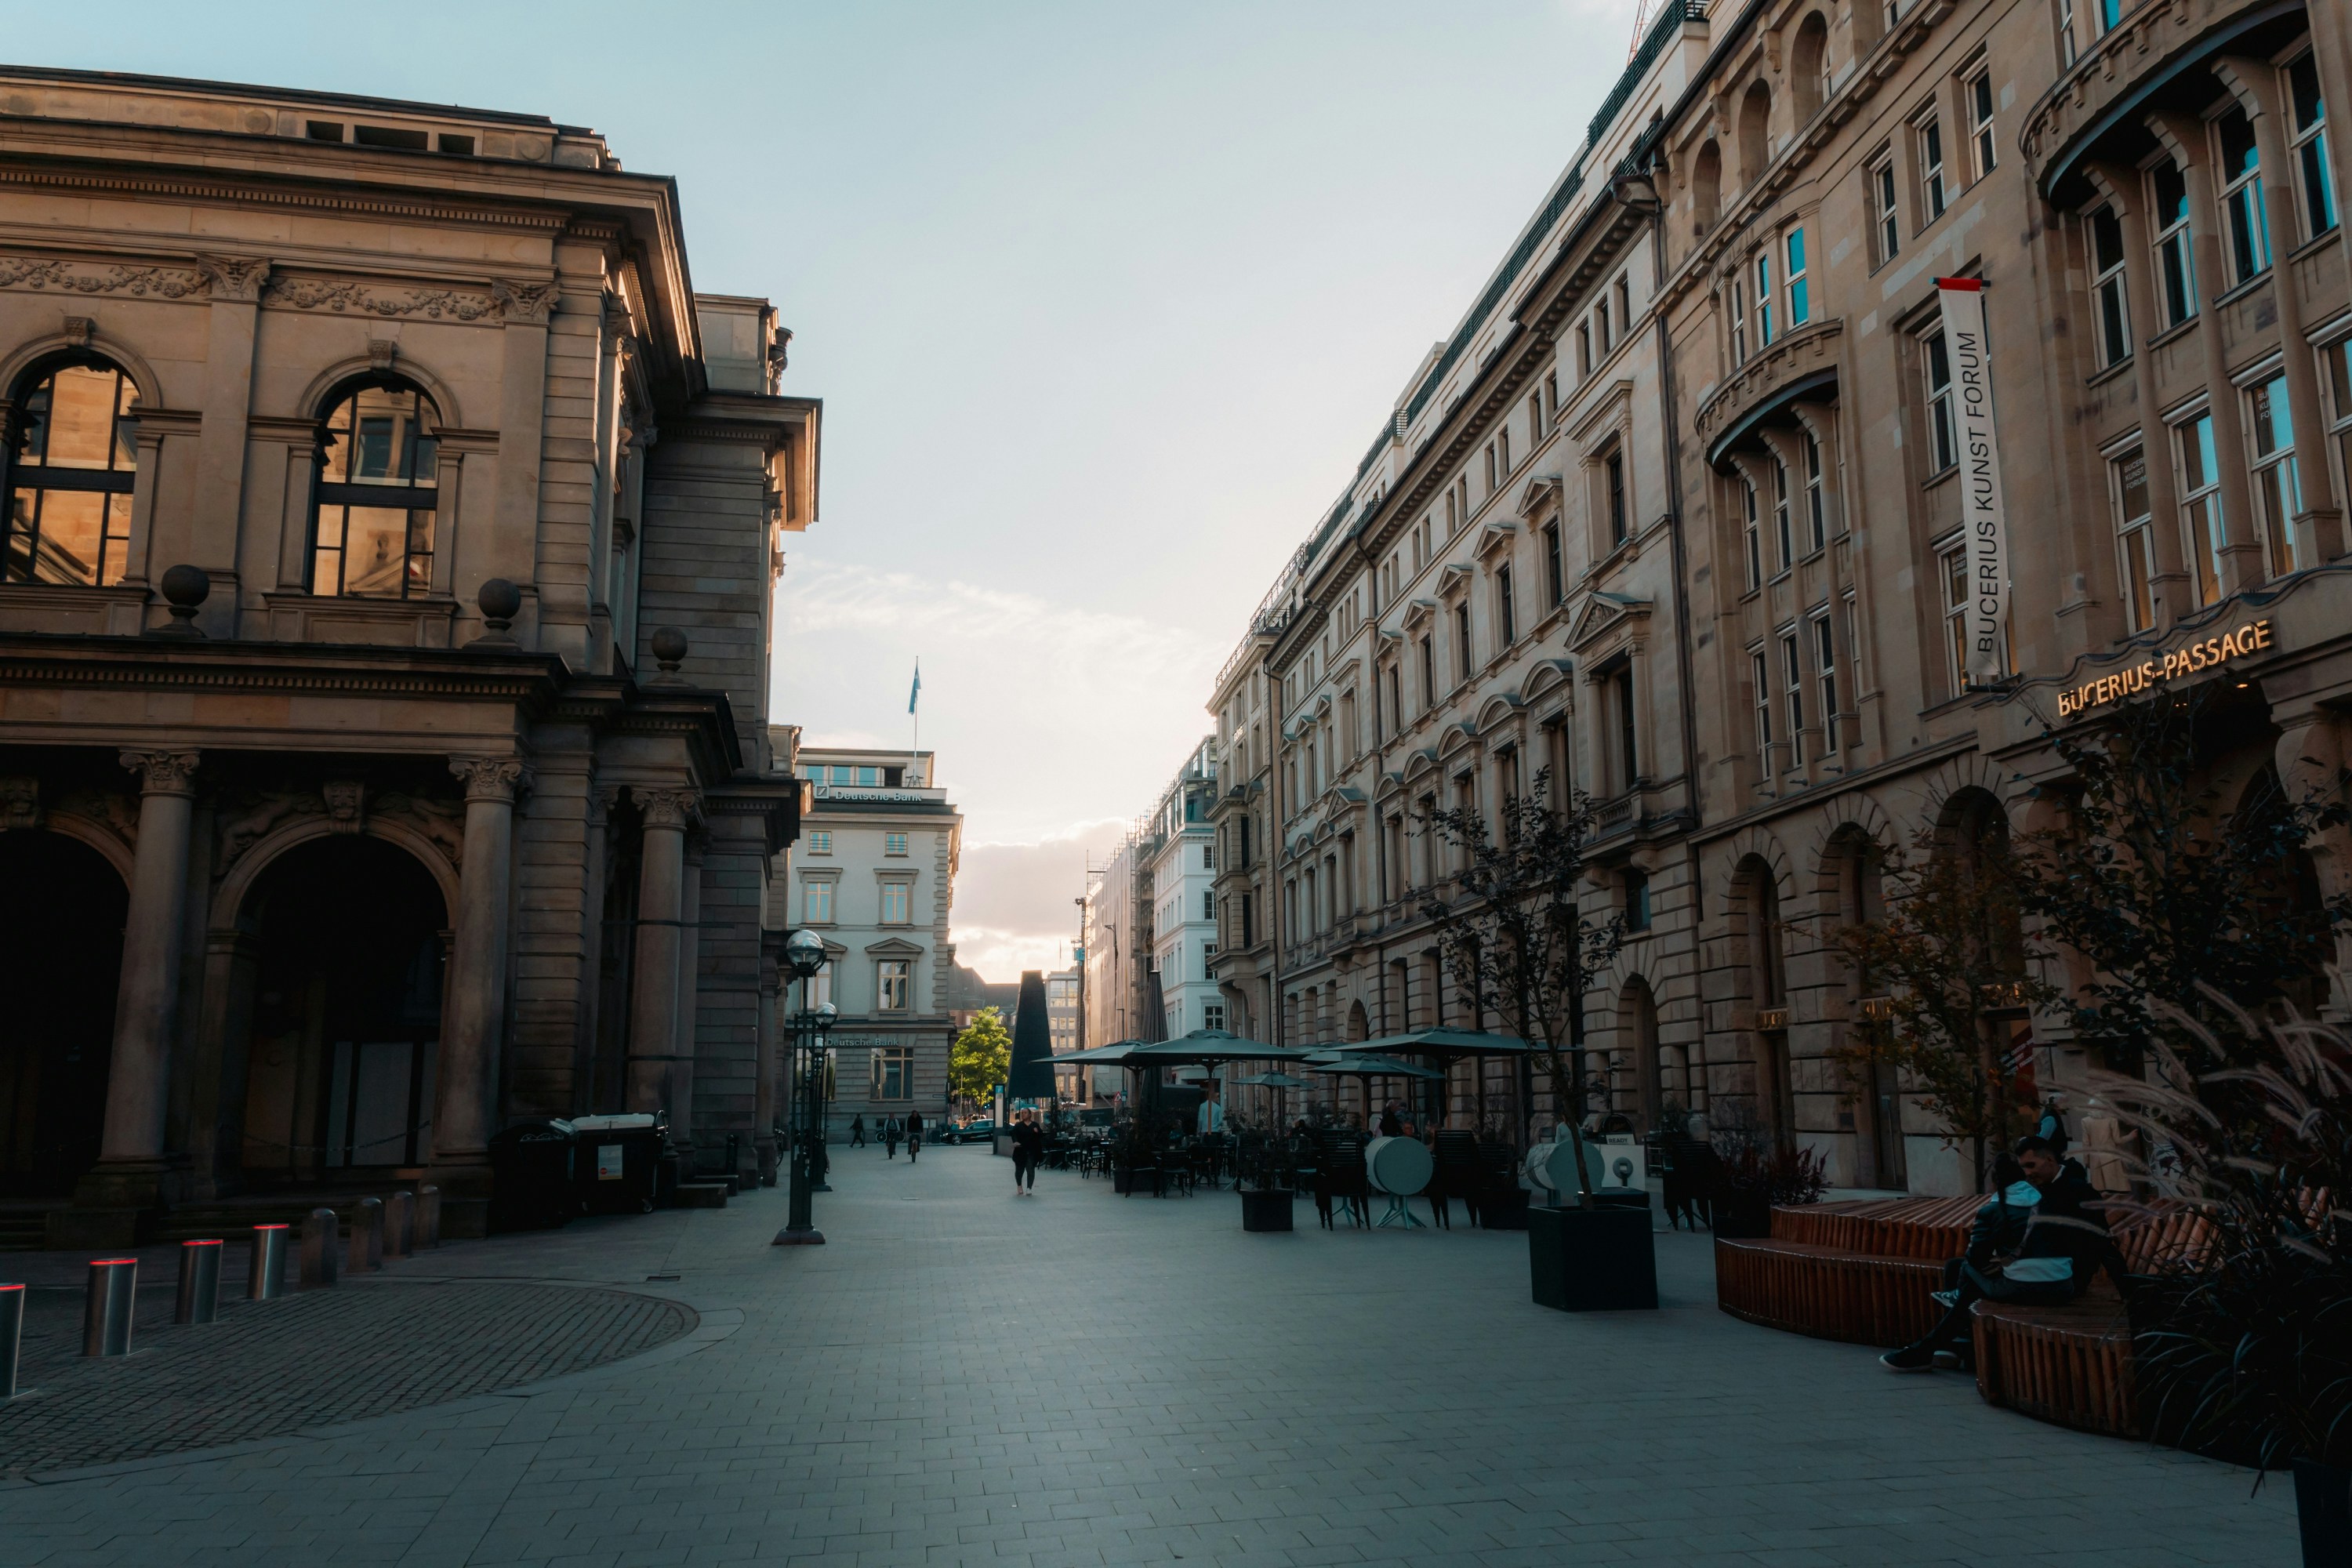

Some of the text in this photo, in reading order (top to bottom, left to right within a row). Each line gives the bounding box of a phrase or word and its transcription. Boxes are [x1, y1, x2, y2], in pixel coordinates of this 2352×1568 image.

[1956, 332, 1998, 652] BUCERIUS KUNST FORUM
[2057, 619, 2271, 717] BUCERIUS-PASSAGE
[826, 1038, 899, 1047] Deutsche Bank
